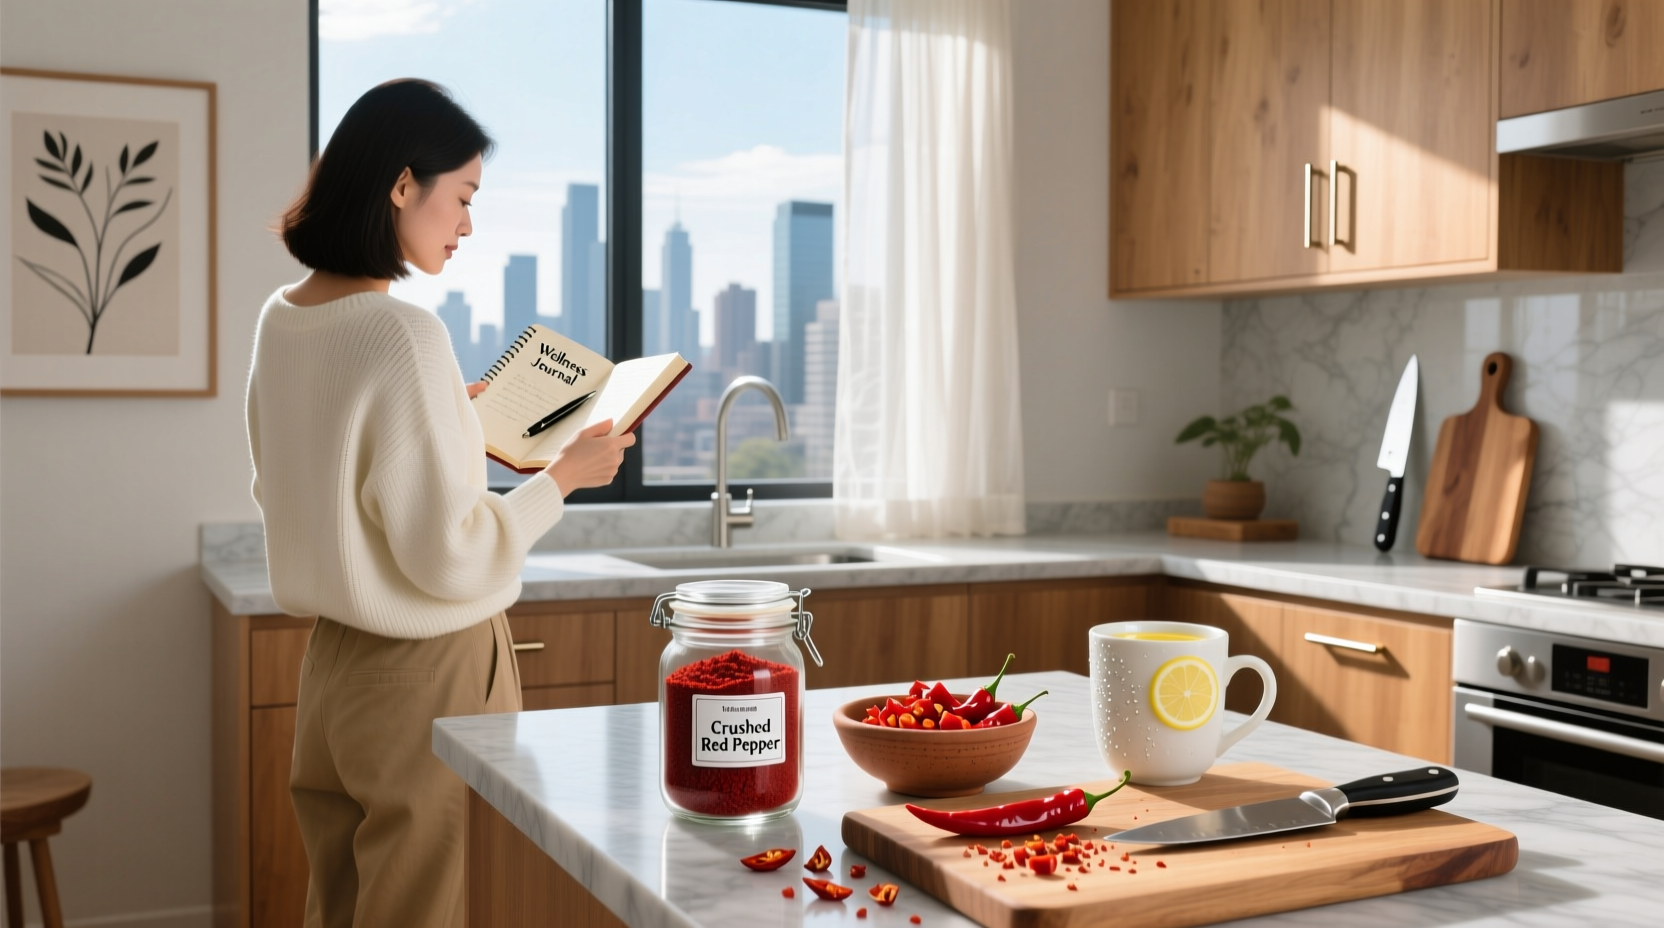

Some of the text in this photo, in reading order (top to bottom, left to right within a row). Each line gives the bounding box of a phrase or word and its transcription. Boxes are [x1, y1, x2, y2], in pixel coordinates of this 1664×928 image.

[711, 718, 771, 735] Crushed
[701, 737, 781, 755] Red Pepper
